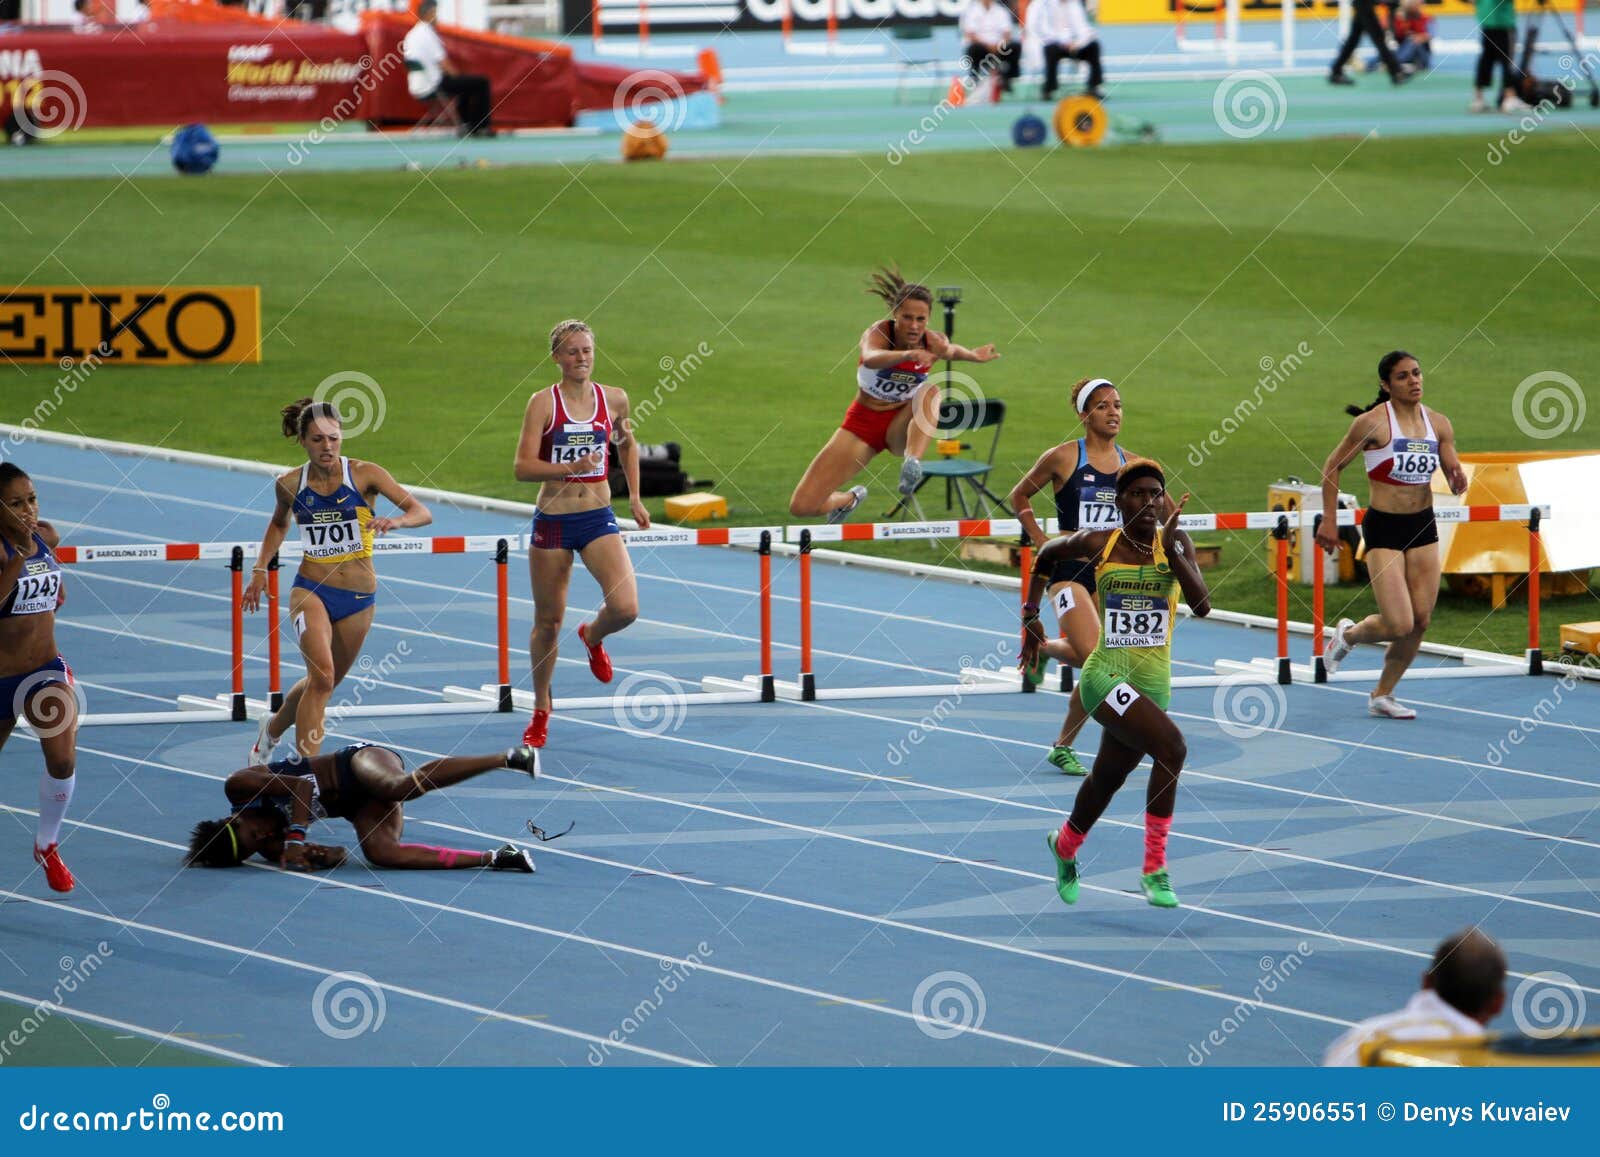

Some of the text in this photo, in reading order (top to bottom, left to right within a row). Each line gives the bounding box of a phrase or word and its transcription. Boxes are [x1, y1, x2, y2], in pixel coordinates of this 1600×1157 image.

[228, 60, 295, 85] World
[1397, 454, 1437, 473] 1683
[306, 522, 355, 546] 1701
[670, 534, 688, 542] 2012
[891, 526, 951, 535] BARCELONA 2012
[96, 549, 158, 558] BARCELONA 2012
[22, 574, 58, 600] 1243
[1060, 593, 1068, 609] 4
[1109, 612, 1163, 634] 1382
[1106, 637, 1150, 646] BARCELONA
[1116, 689, 1131, 706] 6
